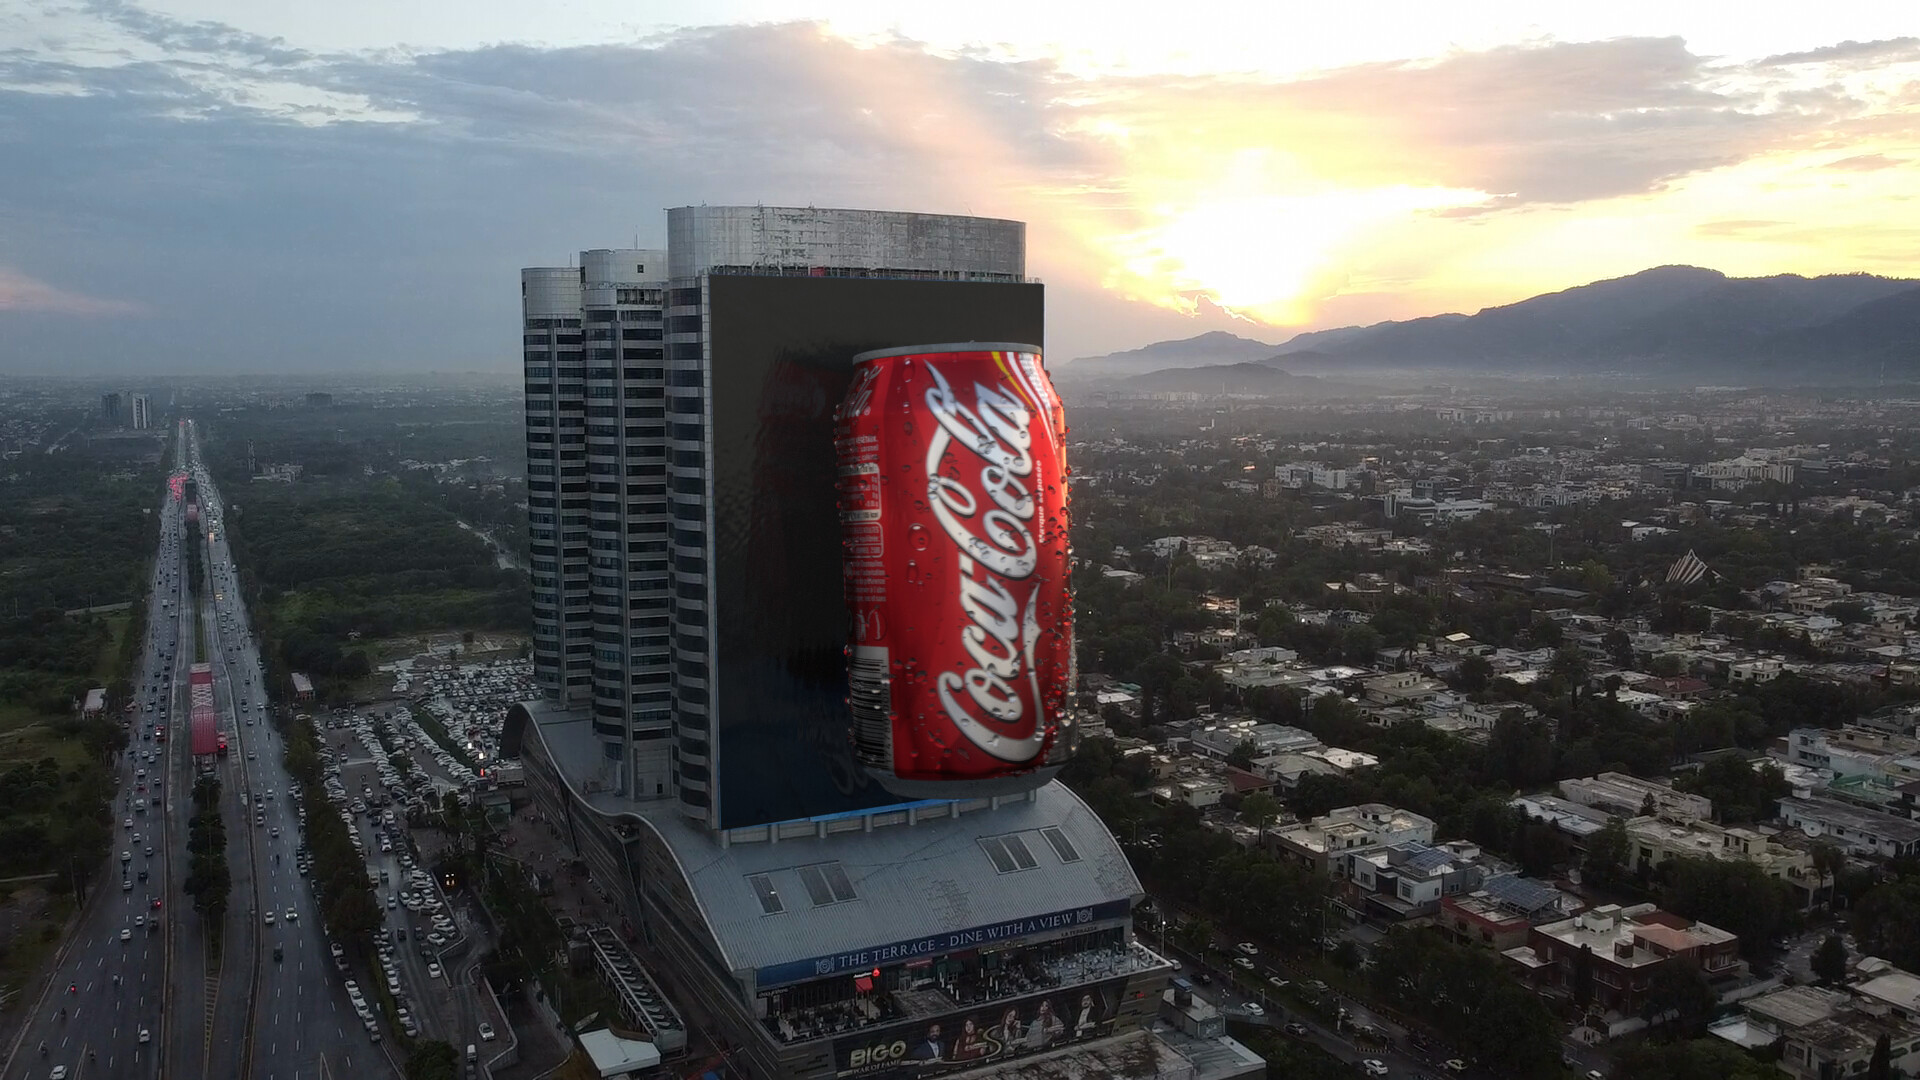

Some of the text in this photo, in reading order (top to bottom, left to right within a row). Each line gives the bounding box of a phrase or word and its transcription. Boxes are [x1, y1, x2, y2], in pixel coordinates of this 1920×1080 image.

[923, 359, 1045, 763] Coca-Cola
[839, 953, 868, 968] THE
[872, 939, 936, 962] TERRACE
[950, 930, 983, 947] DINE
[987, 922, 1024, 940] WITH
[1028, 921, 1036, 932] A
[1039, 913, 1073, 928] VIEW
[850, 1040, 907, 1067] BIGO
